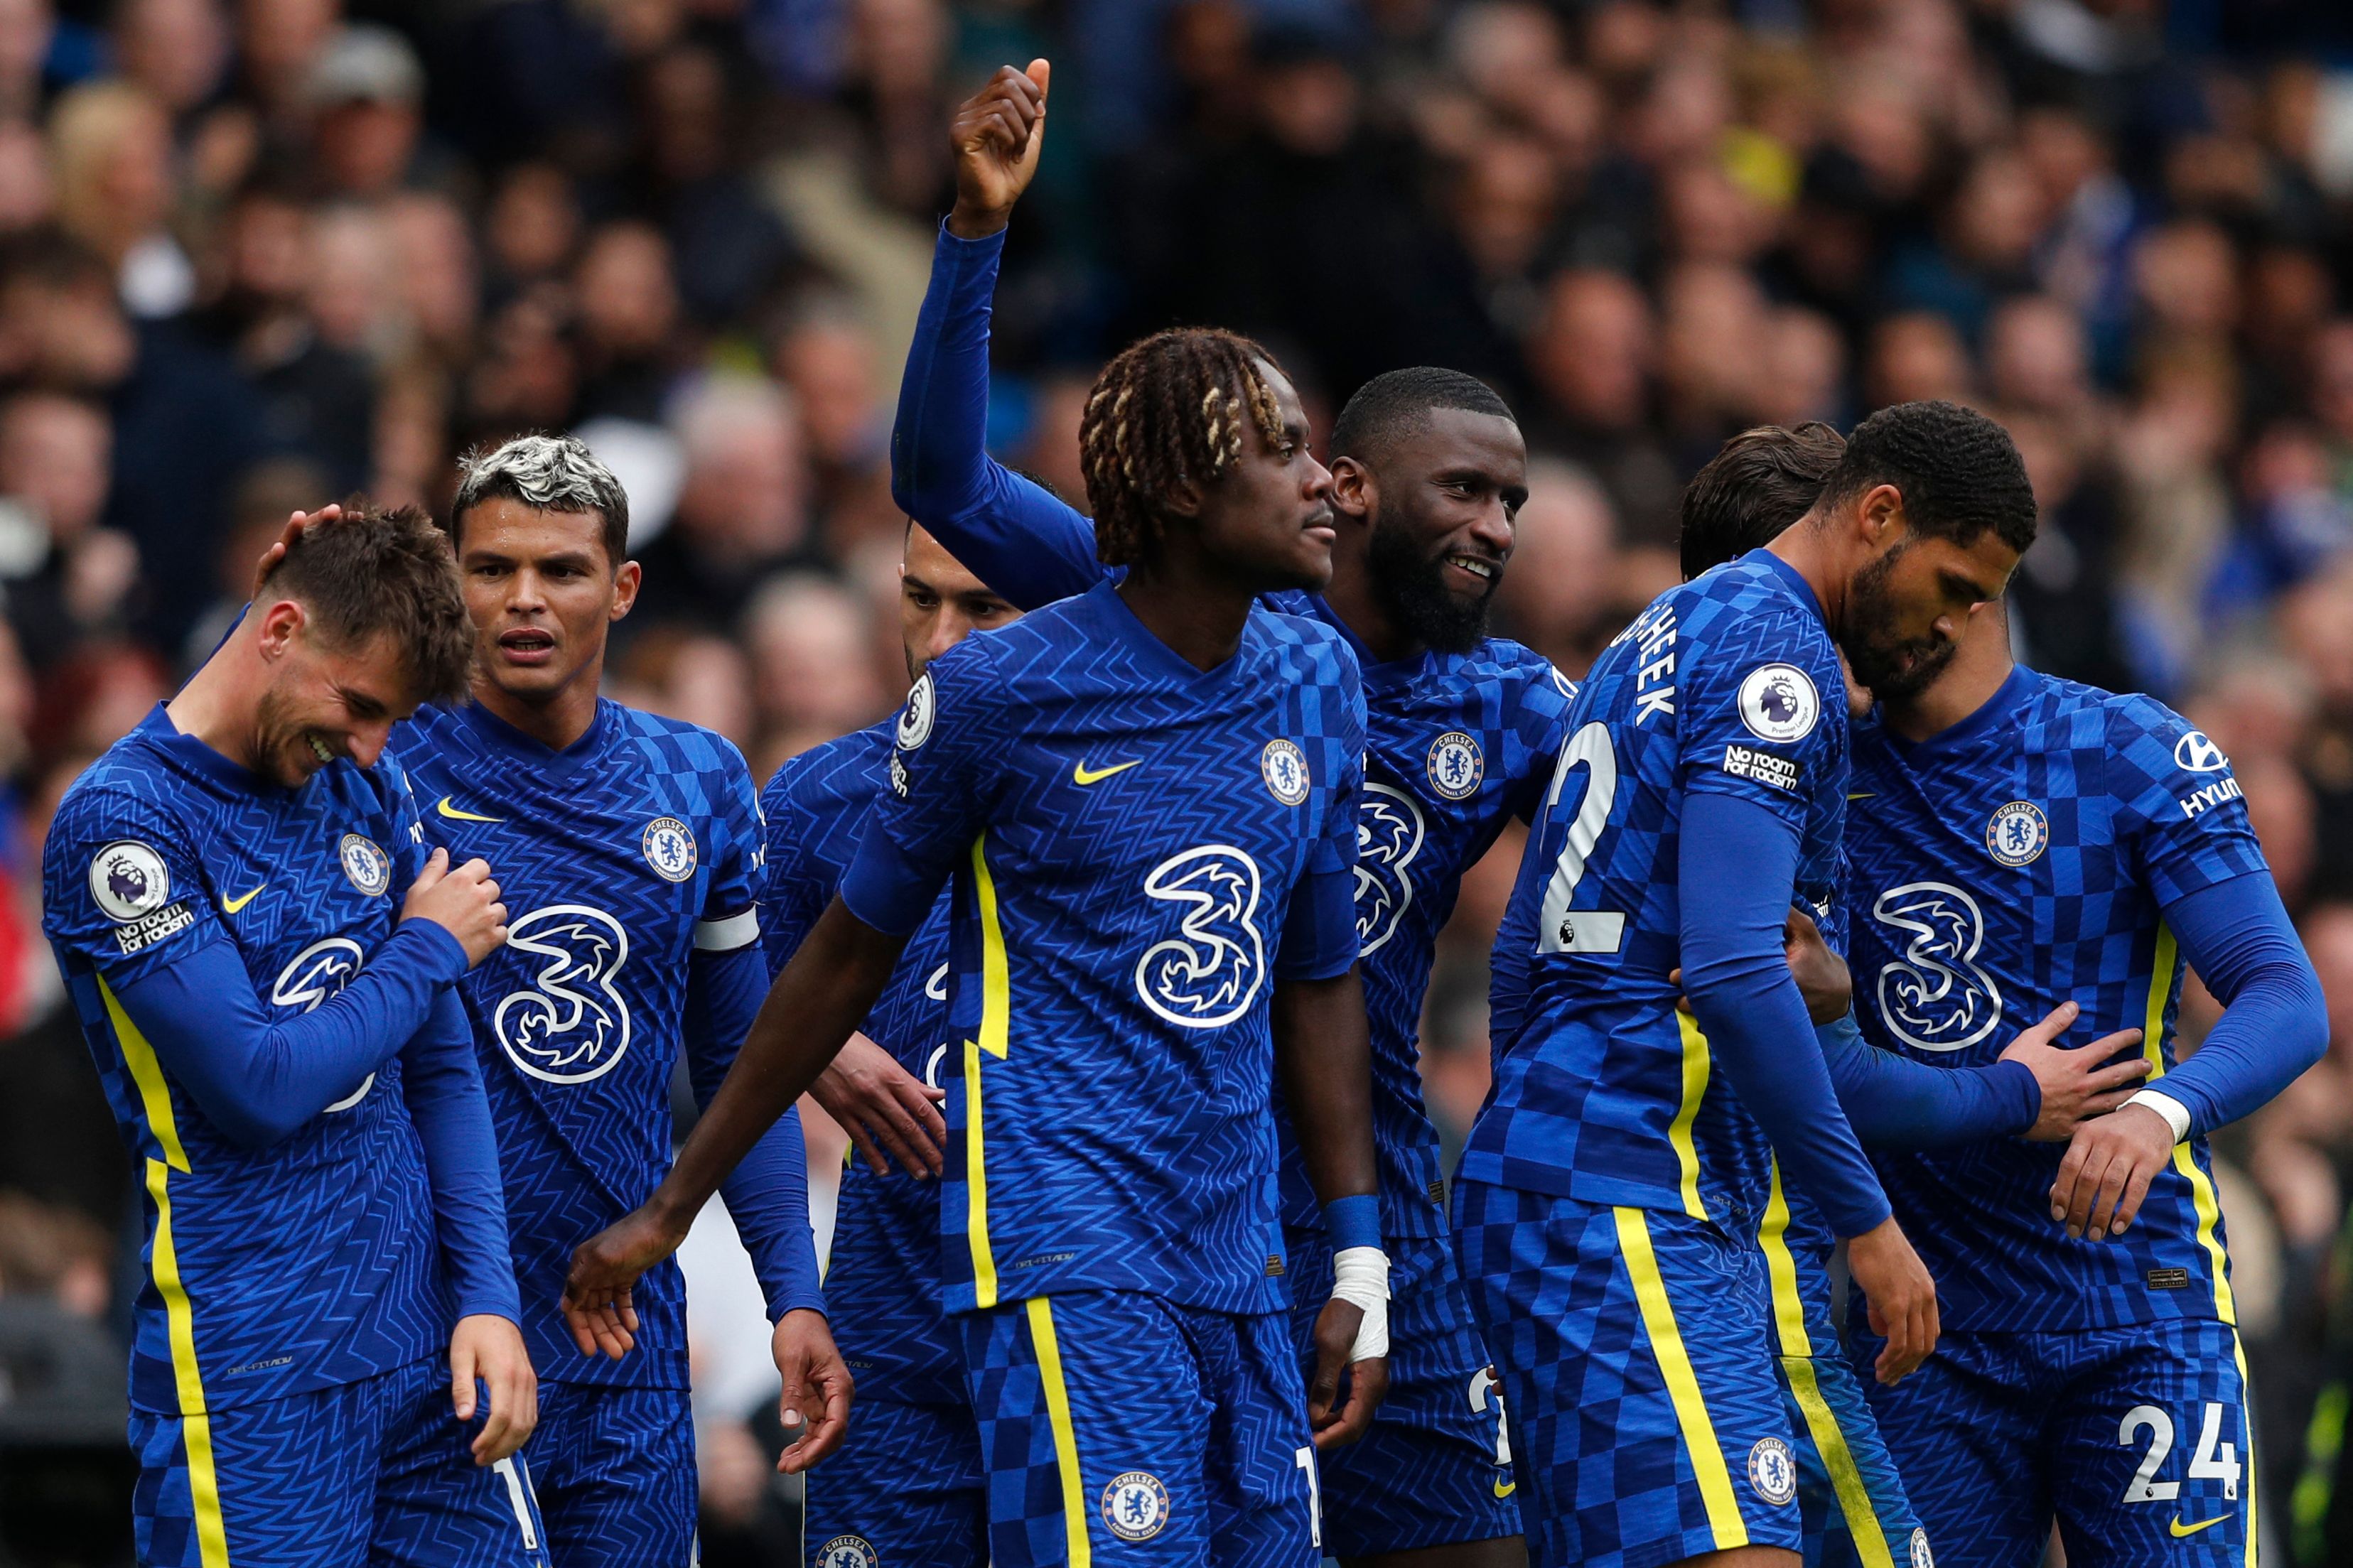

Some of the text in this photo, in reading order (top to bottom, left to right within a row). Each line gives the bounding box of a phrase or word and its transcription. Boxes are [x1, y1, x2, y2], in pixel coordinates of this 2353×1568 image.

[1772, 705, 1809, 735] Premier League
[1267, 742, 1298, 757] CHELSEA
[1438, 735, 1474, 752] CHELSEA
[1725, 745, 1796, 777] No room
[1723, 759, 1797, 790] for racism
[1436, 782, 1458, 796] FOOTBALL
[1998, 804, 2037, 819] CHELSEA
[650, 820, 685, 836] CHELSEA
[343, 836, 367, 853] CHELSEA
[1996, 849, 2037, 863] FOOTBALL CLUB
[114, 903, 183, 943] No room
[120, 910, 195, 956] for racism
[1755, 1440, 1787, 1455] CHELSEA
[2119, 1402, 2241, 1503] 24
[1115, 1474, 1159, 1491] CHELSEA
[1111, 1523, 1141, 1537] FOOTBALL
[826, 1537, 866, 1552] CHELSEA
